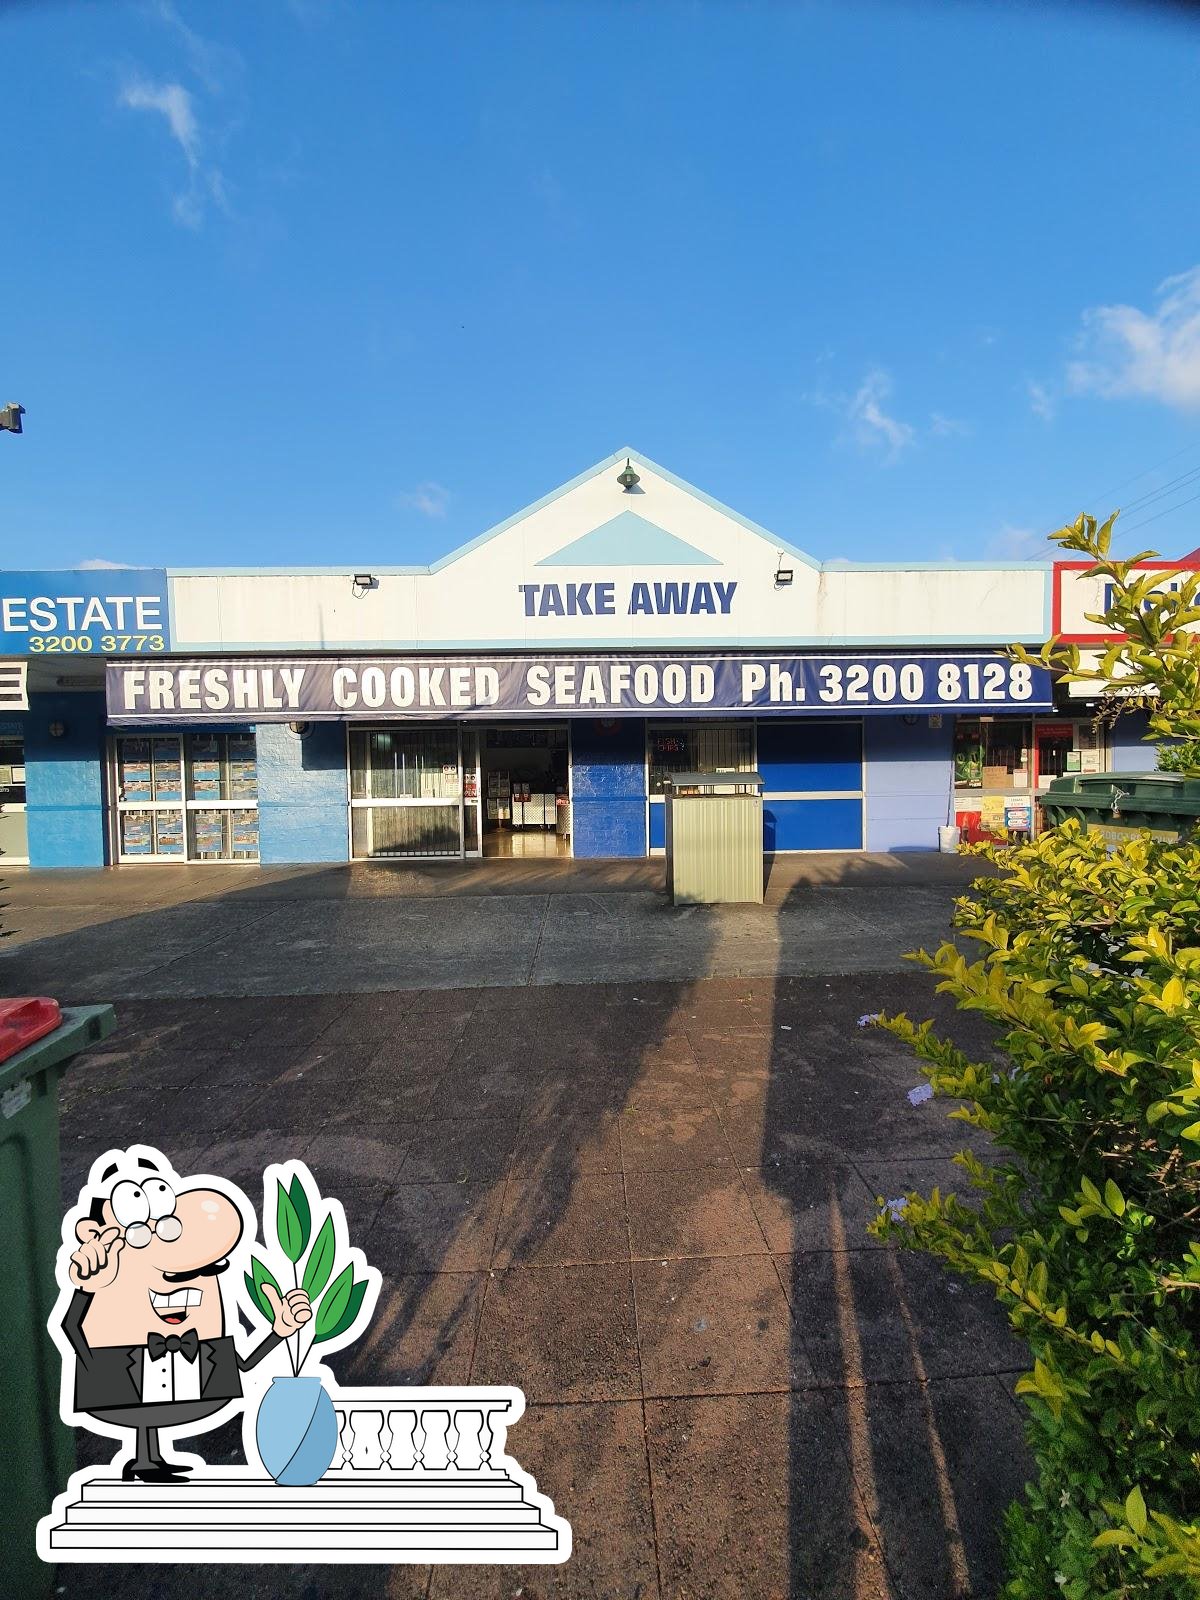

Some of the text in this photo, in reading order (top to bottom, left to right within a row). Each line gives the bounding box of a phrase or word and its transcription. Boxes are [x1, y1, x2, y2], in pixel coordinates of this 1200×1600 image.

[2, 596, 163, 632] ESTATE
[518, 581, 738, 617] TAKE AWAY
[29, 635, 165, 653] 3200 3773
[123, 663, 1033, 710] FRESHLY COOKED SEAFOOD Ph. 3200 8128
